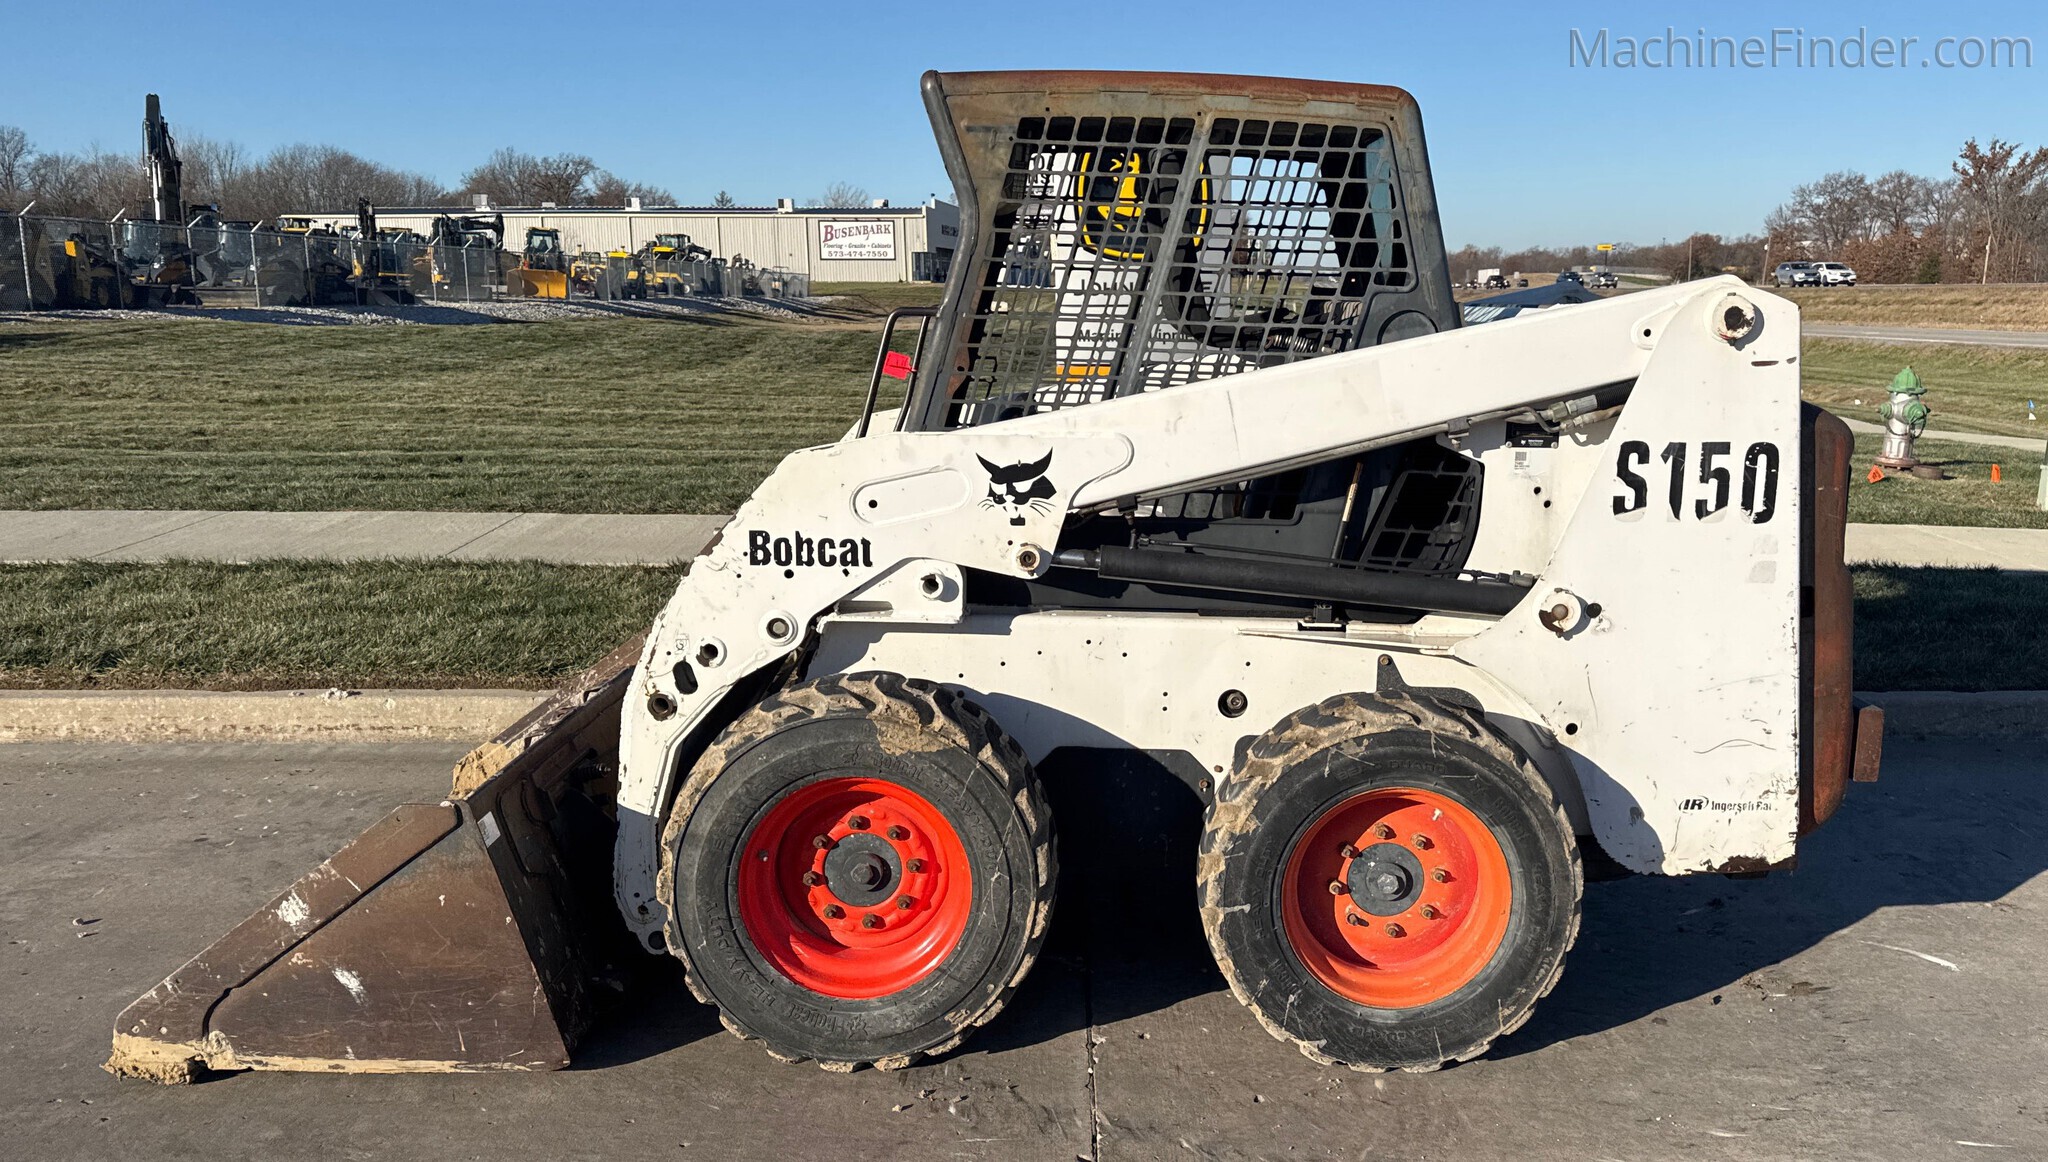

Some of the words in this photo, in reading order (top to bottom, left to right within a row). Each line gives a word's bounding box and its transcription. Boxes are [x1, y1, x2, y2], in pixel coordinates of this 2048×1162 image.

[828, 250, 888, 258] 573-474-7550
[1613, 440, 1780, 524] S150
[748, 530, 873, 567] Bobcat
